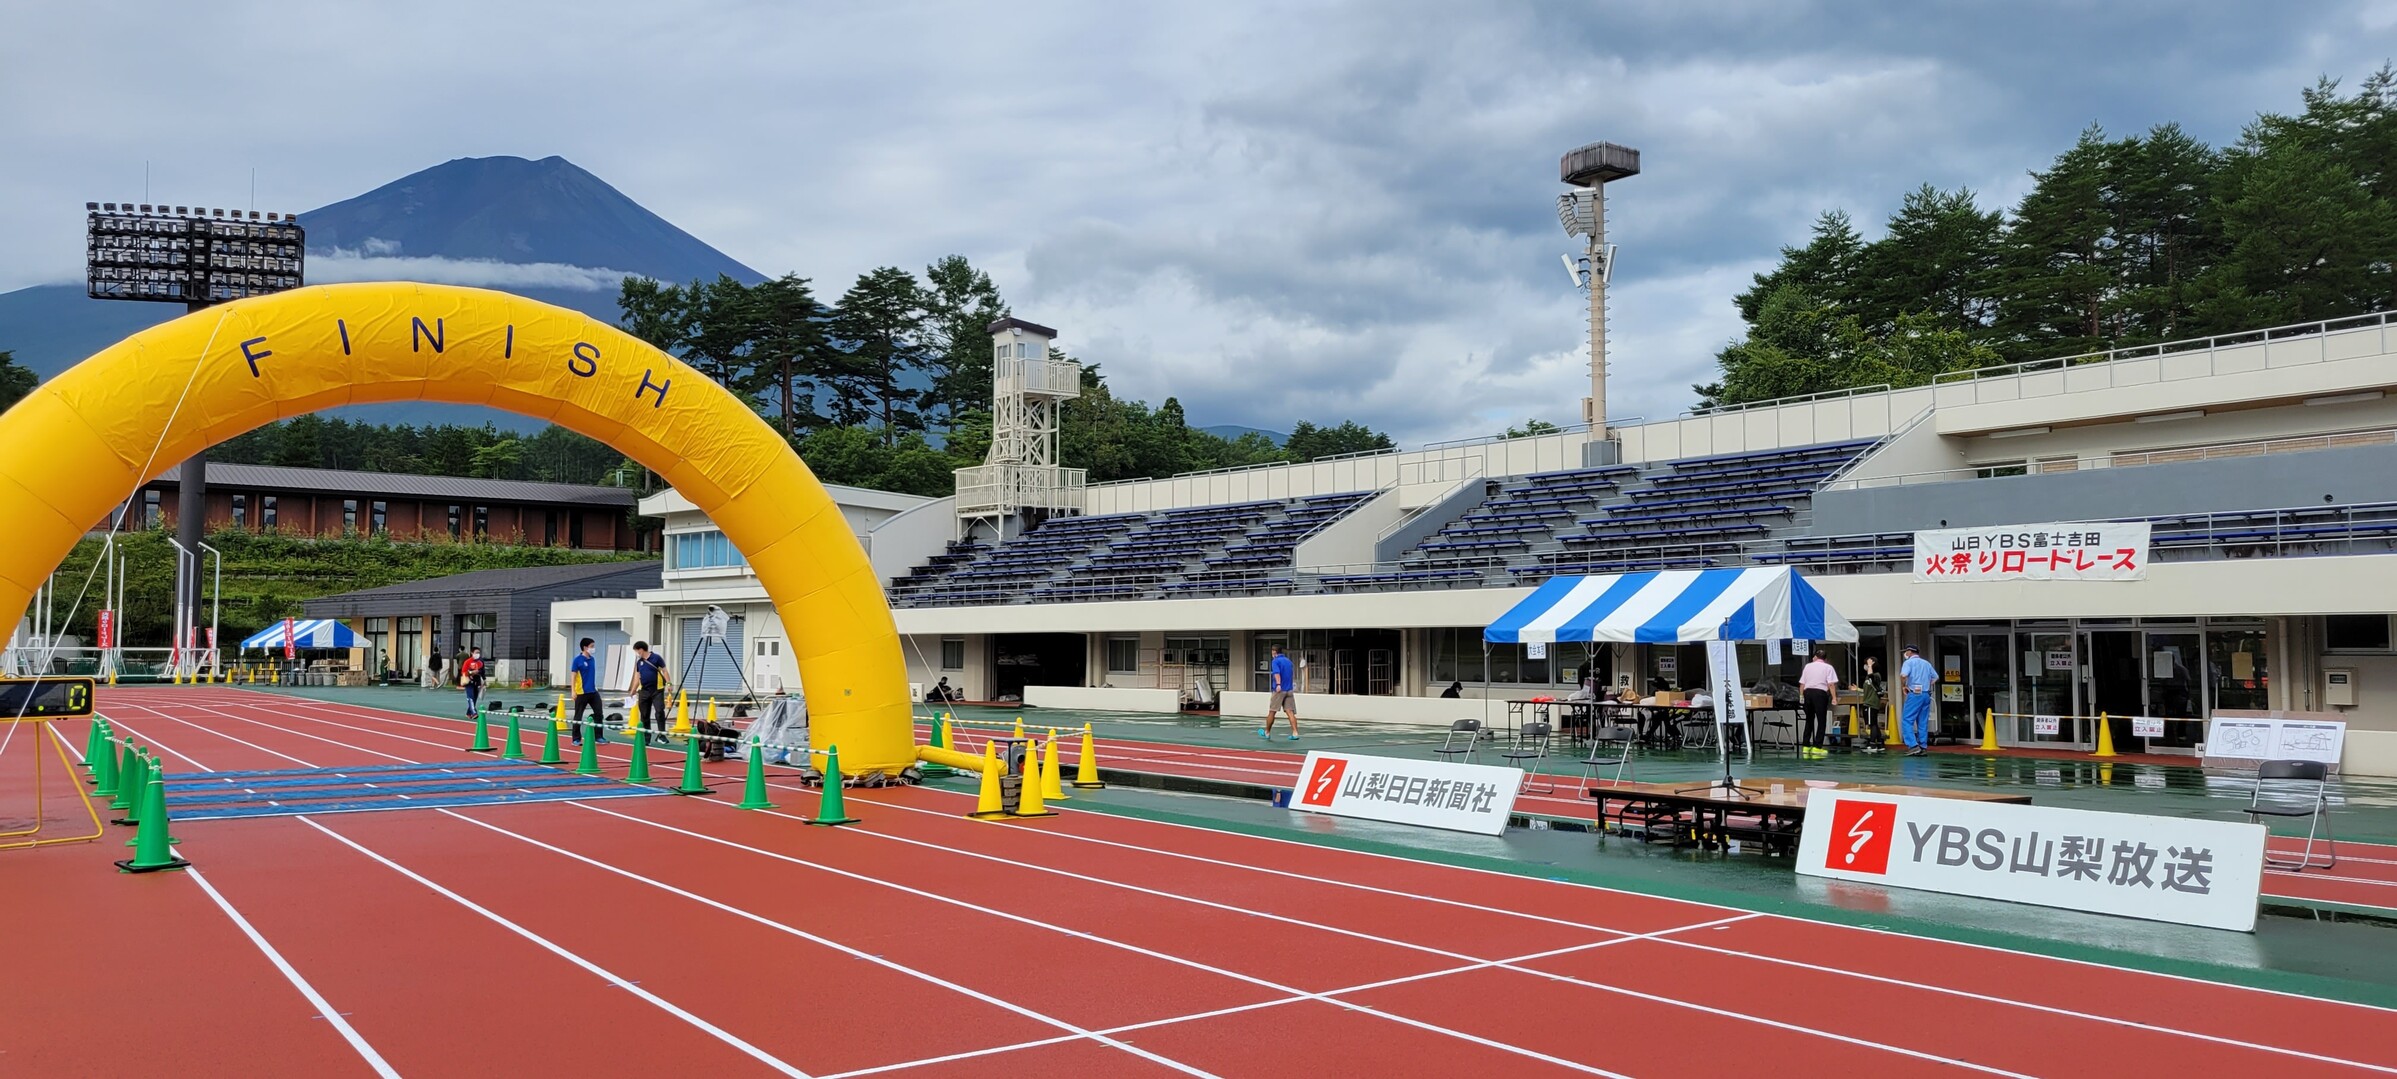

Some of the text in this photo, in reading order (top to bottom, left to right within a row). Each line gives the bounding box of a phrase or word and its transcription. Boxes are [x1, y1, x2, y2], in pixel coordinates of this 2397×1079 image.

[239, 316, 671, 409] FINISH
[1925, 548, 2137, 576] 火祭りロードレース
[1951, 531, 2102, 552] 山日YBS富士吉田
[1341, 771, 1498, 815] 山梨日日新聞社
[1905, 821, 2214, 896] YBS山梨放送
